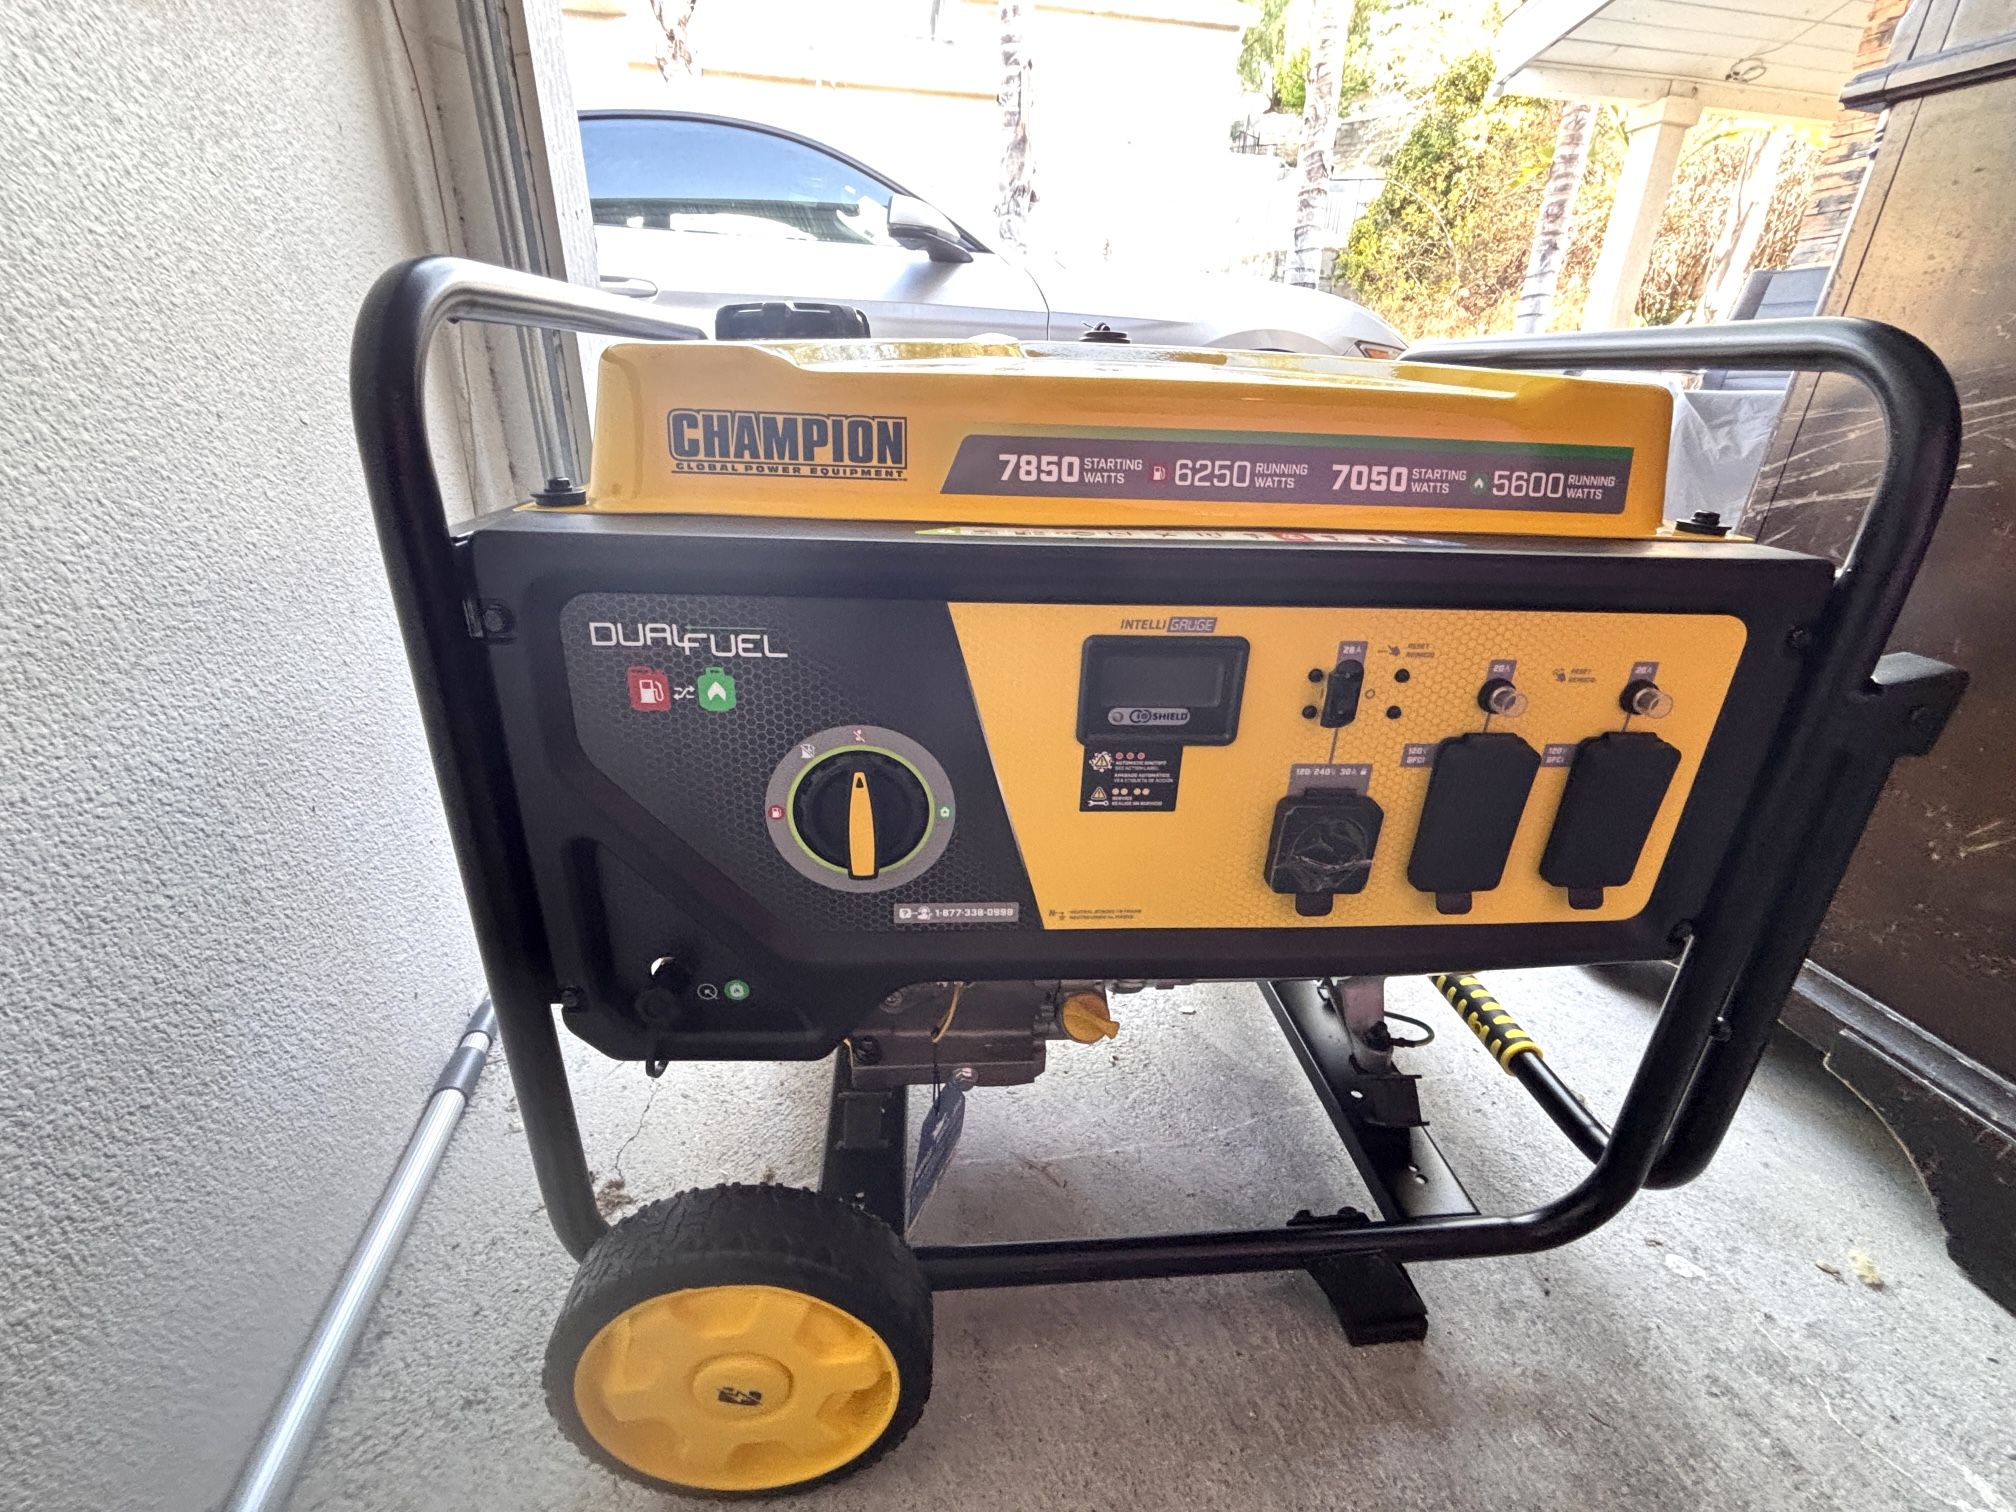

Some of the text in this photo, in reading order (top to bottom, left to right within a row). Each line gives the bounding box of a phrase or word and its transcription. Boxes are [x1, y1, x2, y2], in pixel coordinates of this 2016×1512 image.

[668, 409, 906, 467] CHAMPION
[675, 461, 904, 478] GLOBAL POWER EQUIPMENT
[998, 454, 1080, 483] 7850
[1083, 457, 1143, 471] STARTING
[1255, 462, 1309, 476] RUNNING
[1083, 471, 1125, 484] WATTS
[1174, 459, 1251, 488] 6250
[1332, 464, 1408, 492] 7050
[1412, 468, 1467, 482] STARTING
[1567, 474, 1616, 487] RUNNING
[1254, 476, 1295, 489] WATTS
[1411, 481, 1449, 494] WATTS
[1492, 470, 1564, 498] 5600
[1566, 487, 1602, 500] WATTS
[1152, 712, 1188, 721] SHIELD
